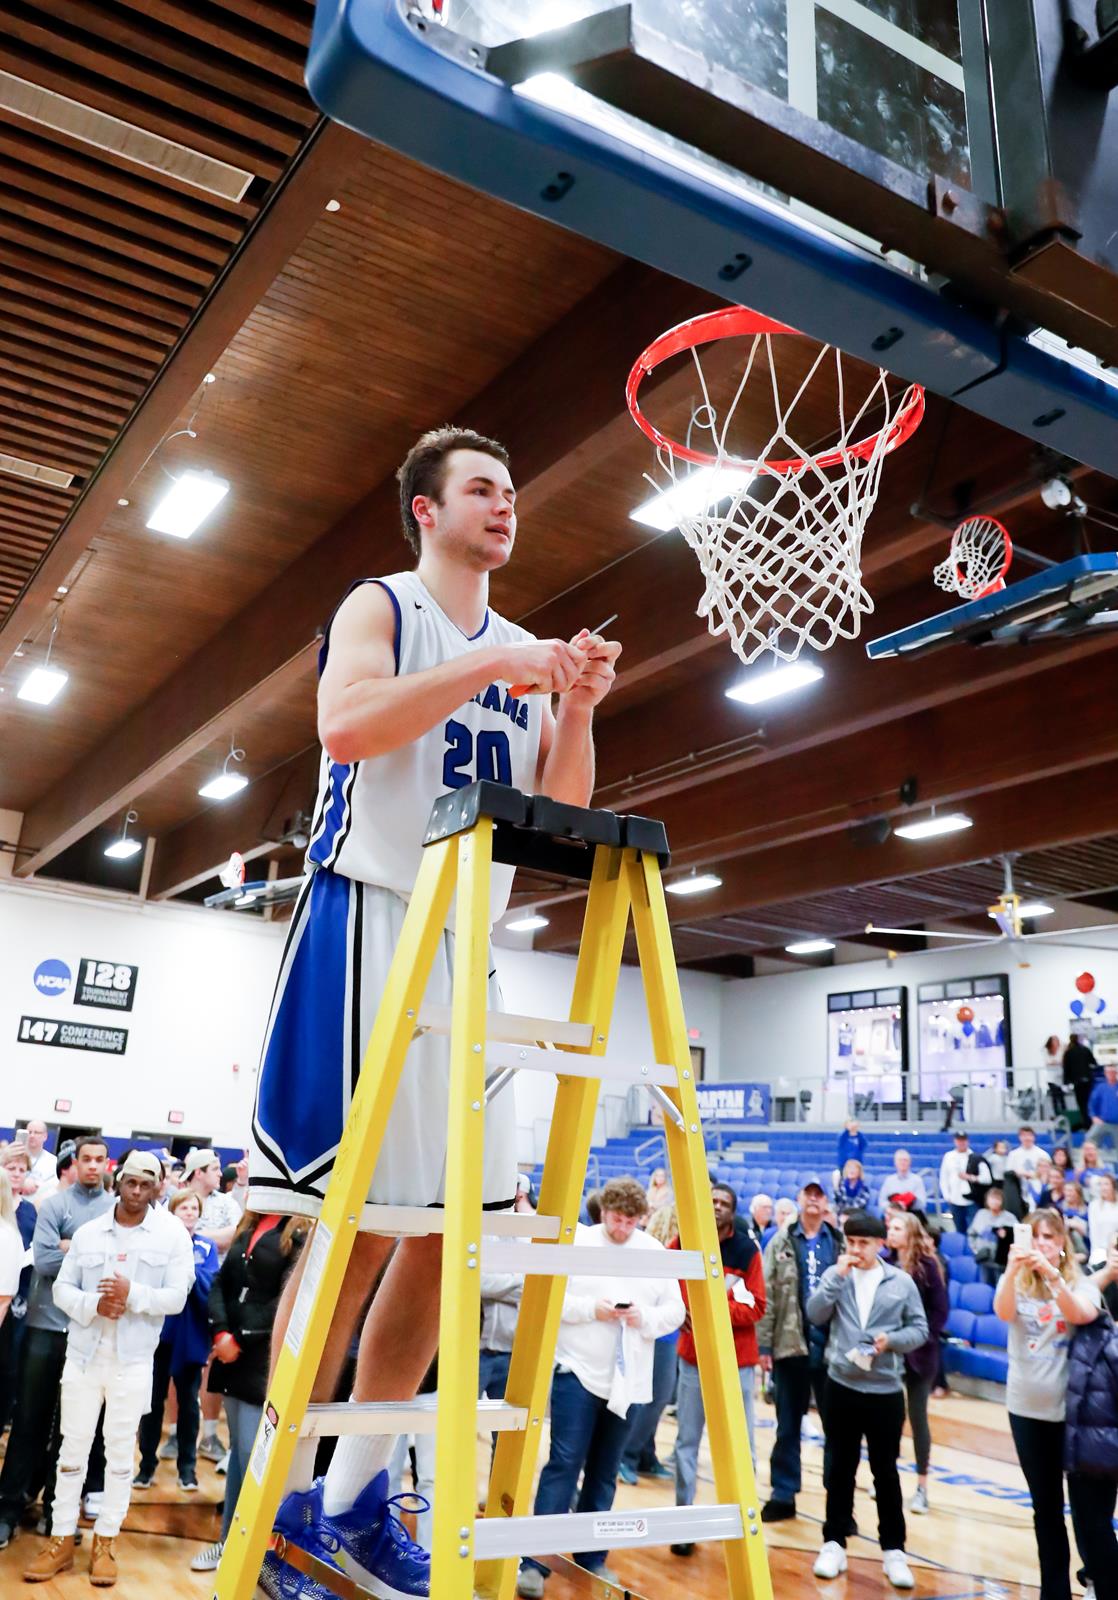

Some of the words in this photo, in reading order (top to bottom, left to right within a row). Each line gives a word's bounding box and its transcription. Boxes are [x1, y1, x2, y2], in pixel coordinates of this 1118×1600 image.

[469, 683, 528, 731] ANS
[443, 719, 512, 789] 20
[36, 974, 71, 990] NCAA
[84, 961, 132, 991] 128
[82, 986, 128, 1000] TOURNAMENT
[20, 1019, 58, 1042] 147
[61, 1025, 125, 1043] CONFERENCE
[60, 1035, 123, 1051] CHAMPIONSHIPS
